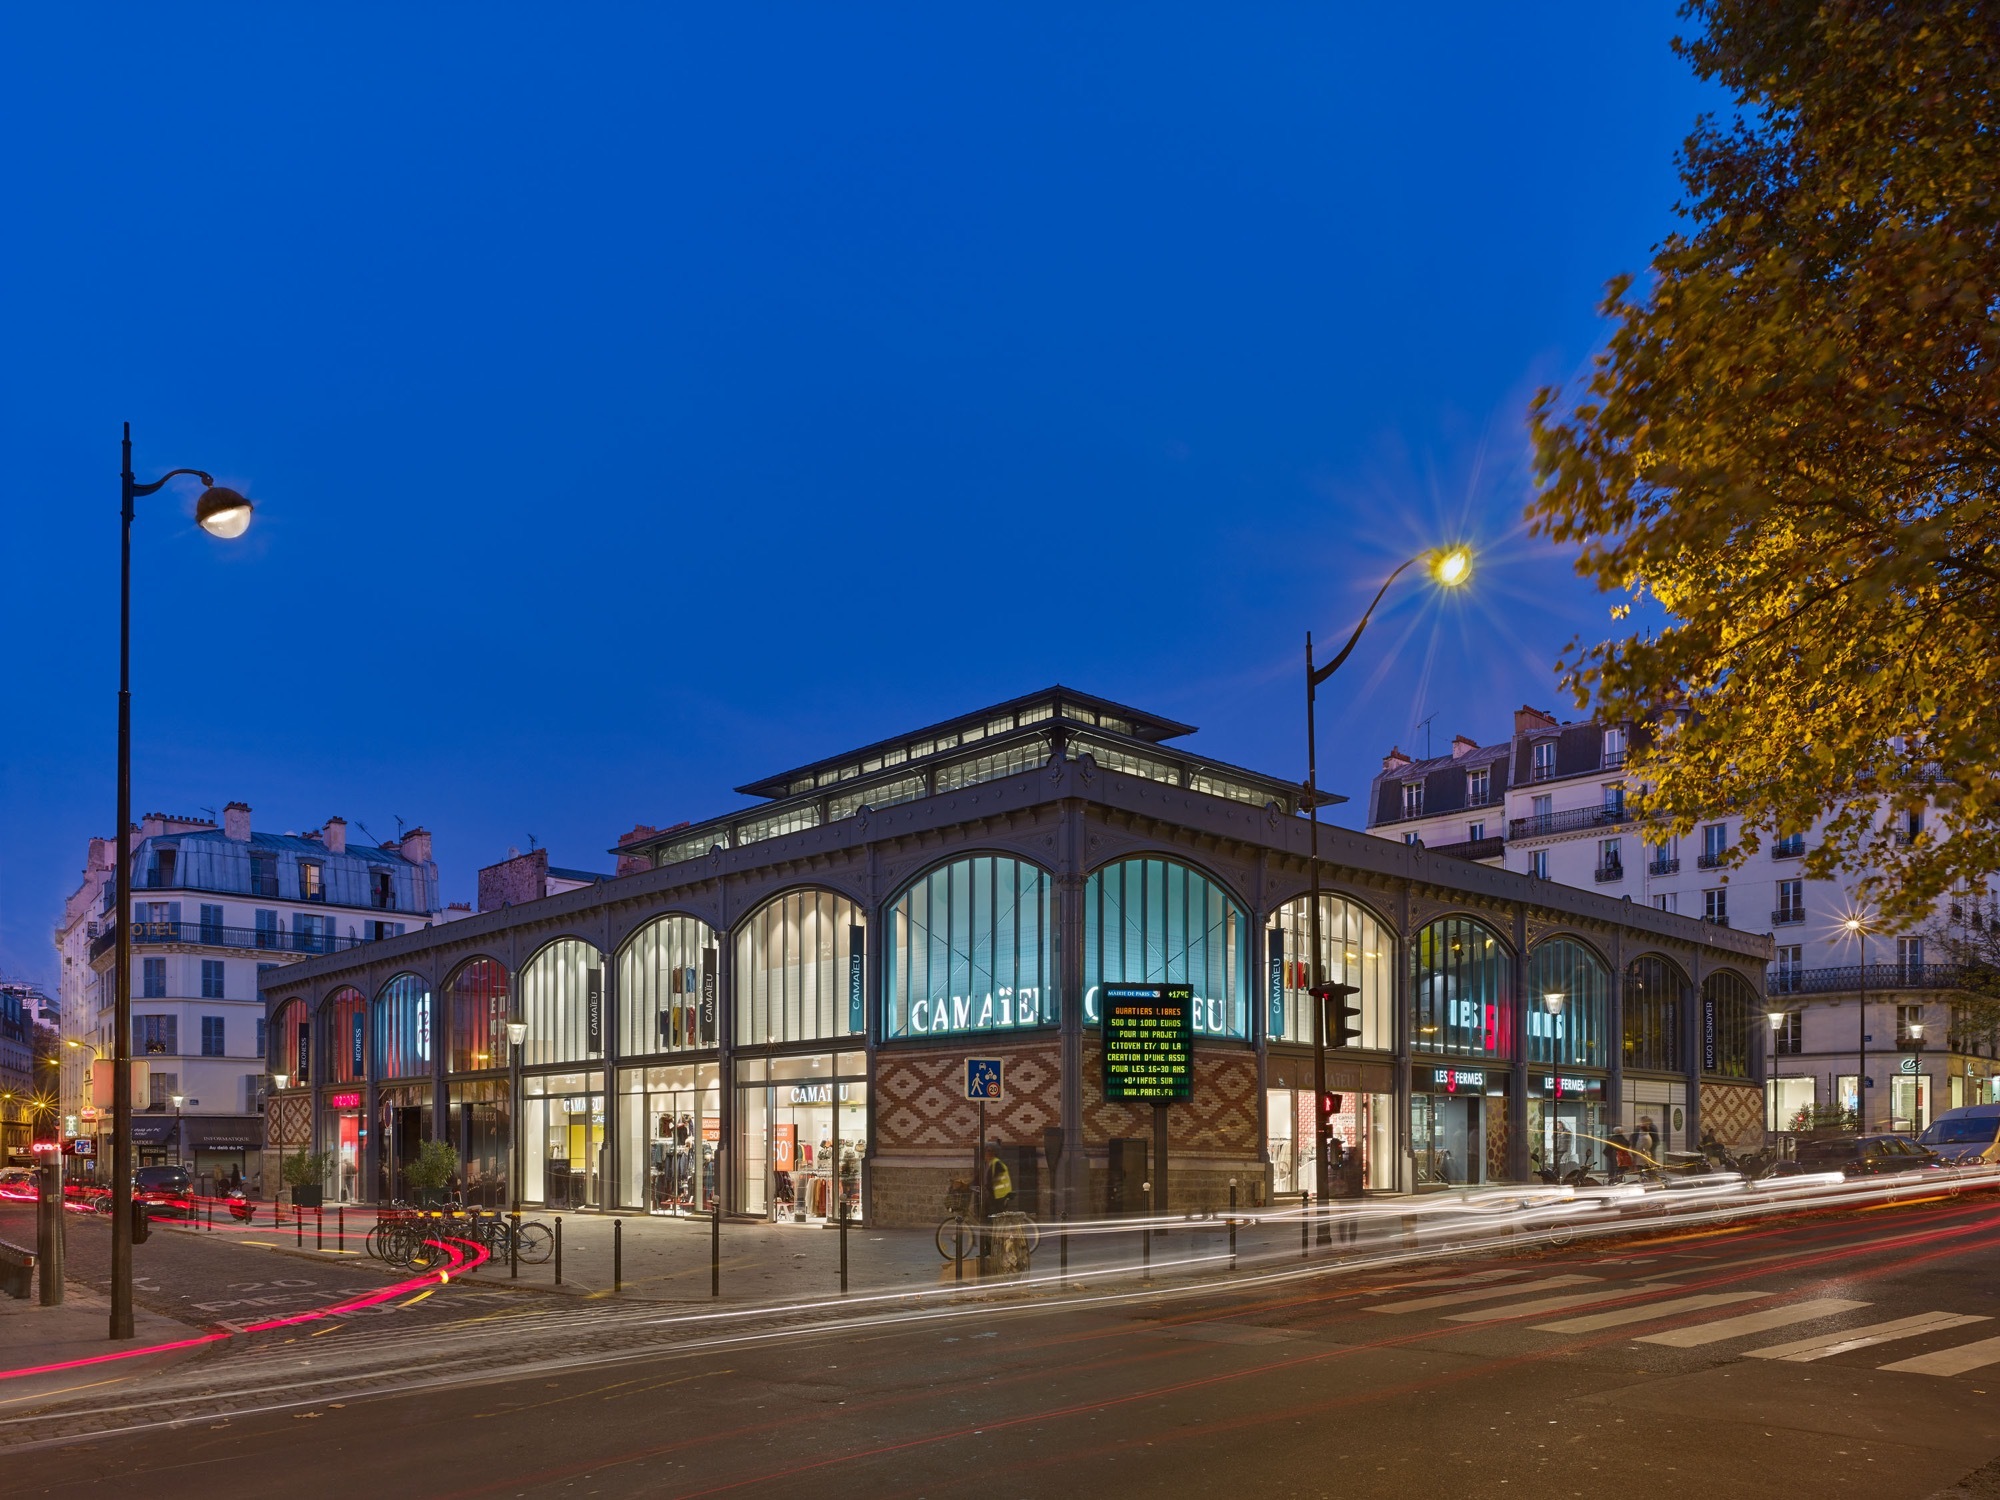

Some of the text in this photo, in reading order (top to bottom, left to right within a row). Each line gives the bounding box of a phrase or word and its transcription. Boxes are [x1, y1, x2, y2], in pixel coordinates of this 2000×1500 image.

[131, 923, 178, 936] OTEL
[1115, 1007, 1181, 1016] QUARTIERS LIBRES
[1119, 1030, 1137, 1038] POUR
[1111, 1042, 1181, 1050] CITOYEN ET/ OU LA
[1107, 1053, 1185, 1062] CREATION D'UNE ASSO
[1111, 1065, 1185, 1073] POUR LES 16-30 ANS
[1123, 1077, 1173, 1085] +D'INFOS SUR
[1434, 1069, 1483, 1093] LES 5 FERMES
[1561, 1078, 1584, 1092] FERMES
[1123, 1088, 1173, 1096] WWW.PARIS.FR
